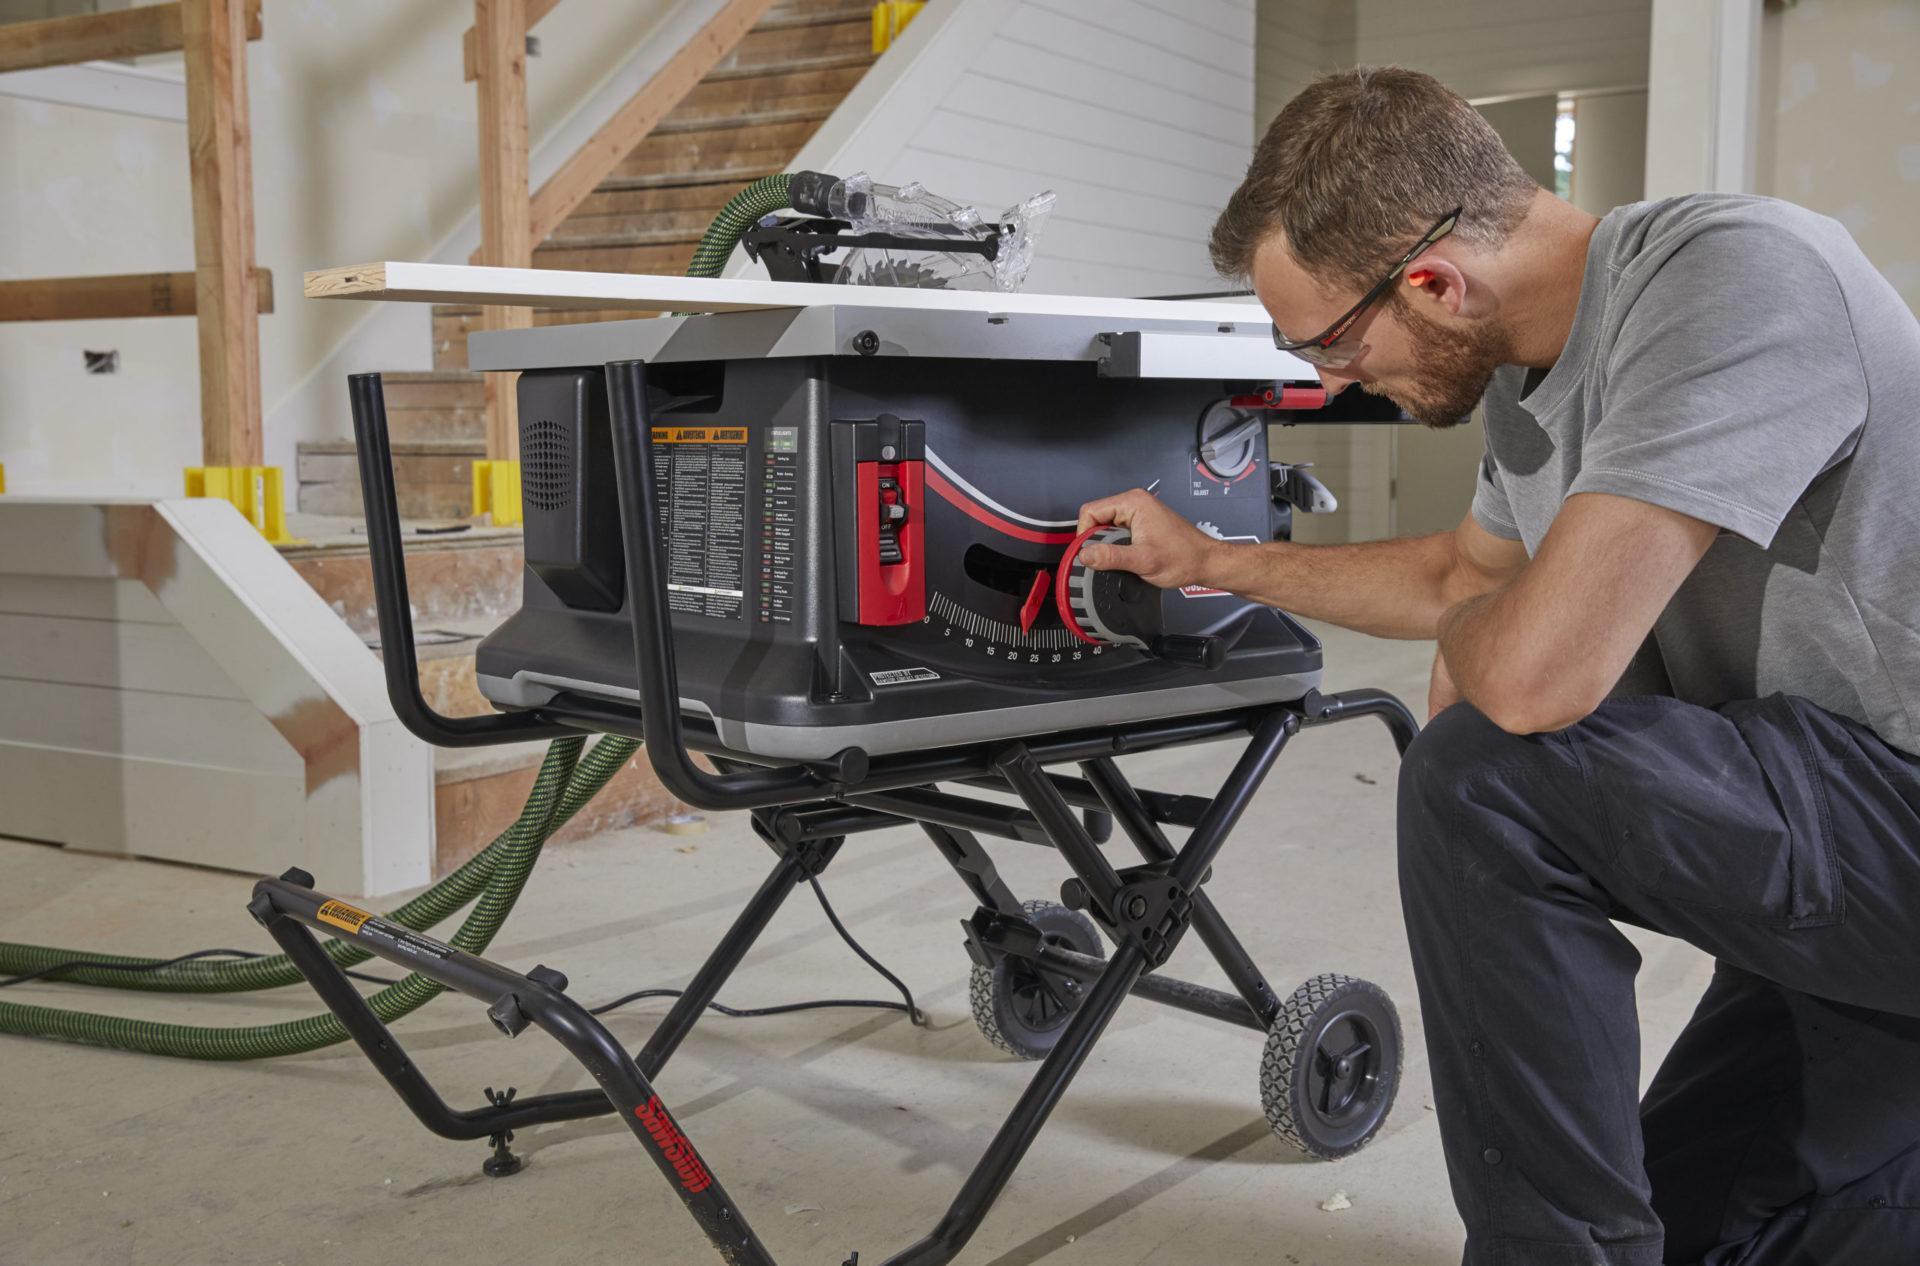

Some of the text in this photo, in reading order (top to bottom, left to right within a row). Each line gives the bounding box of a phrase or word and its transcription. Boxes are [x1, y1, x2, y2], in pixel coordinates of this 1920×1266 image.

[944, 628, 951, 637] 5
[965, 638, 974, 648] 10
[986, 646, 995, 656] 15
[1092, 645, 1102, 655] 40
[1007, 651, 1018, 660] 20
[1029, 653, 1040, 663] 25
[1051, 653, 1062, 663] 30
[1072, 651, 1082, 661] 35
[329, 904, 361, 926] WARNING
[634, 1093, 711, 1193] SawStop
